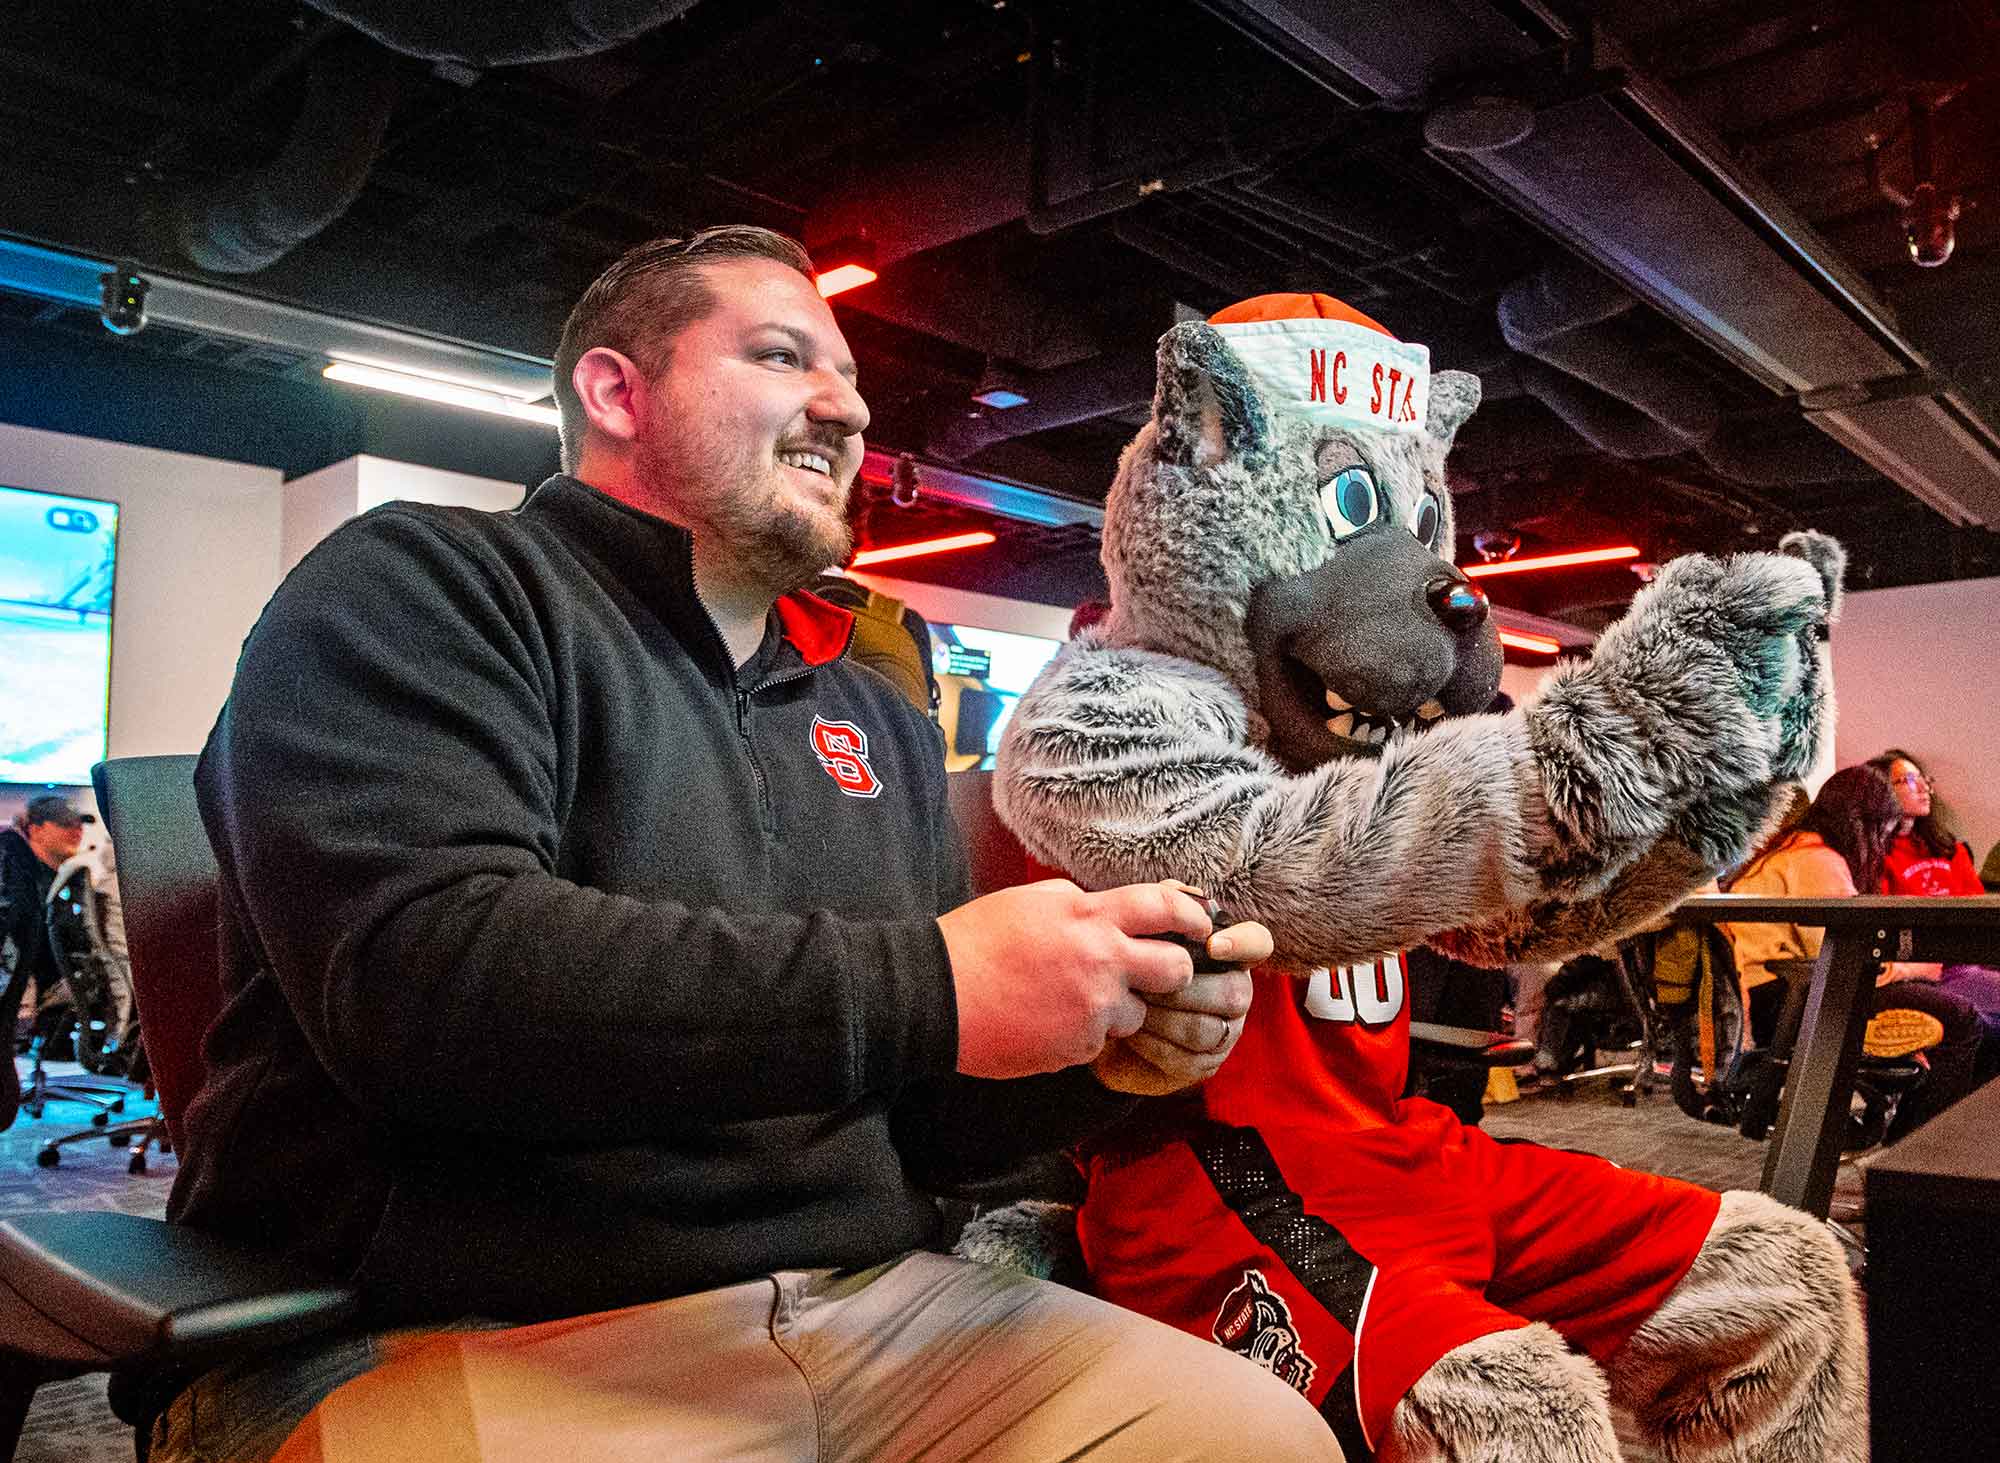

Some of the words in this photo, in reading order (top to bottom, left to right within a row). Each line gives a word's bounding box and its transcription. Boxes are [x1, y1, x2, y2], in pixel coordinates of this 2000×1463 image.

[1310, 348, 1348, 405] NC
[1224, 1325, 1236, 1340] NC
[1234, 1301, 1253, 1331] STATE
